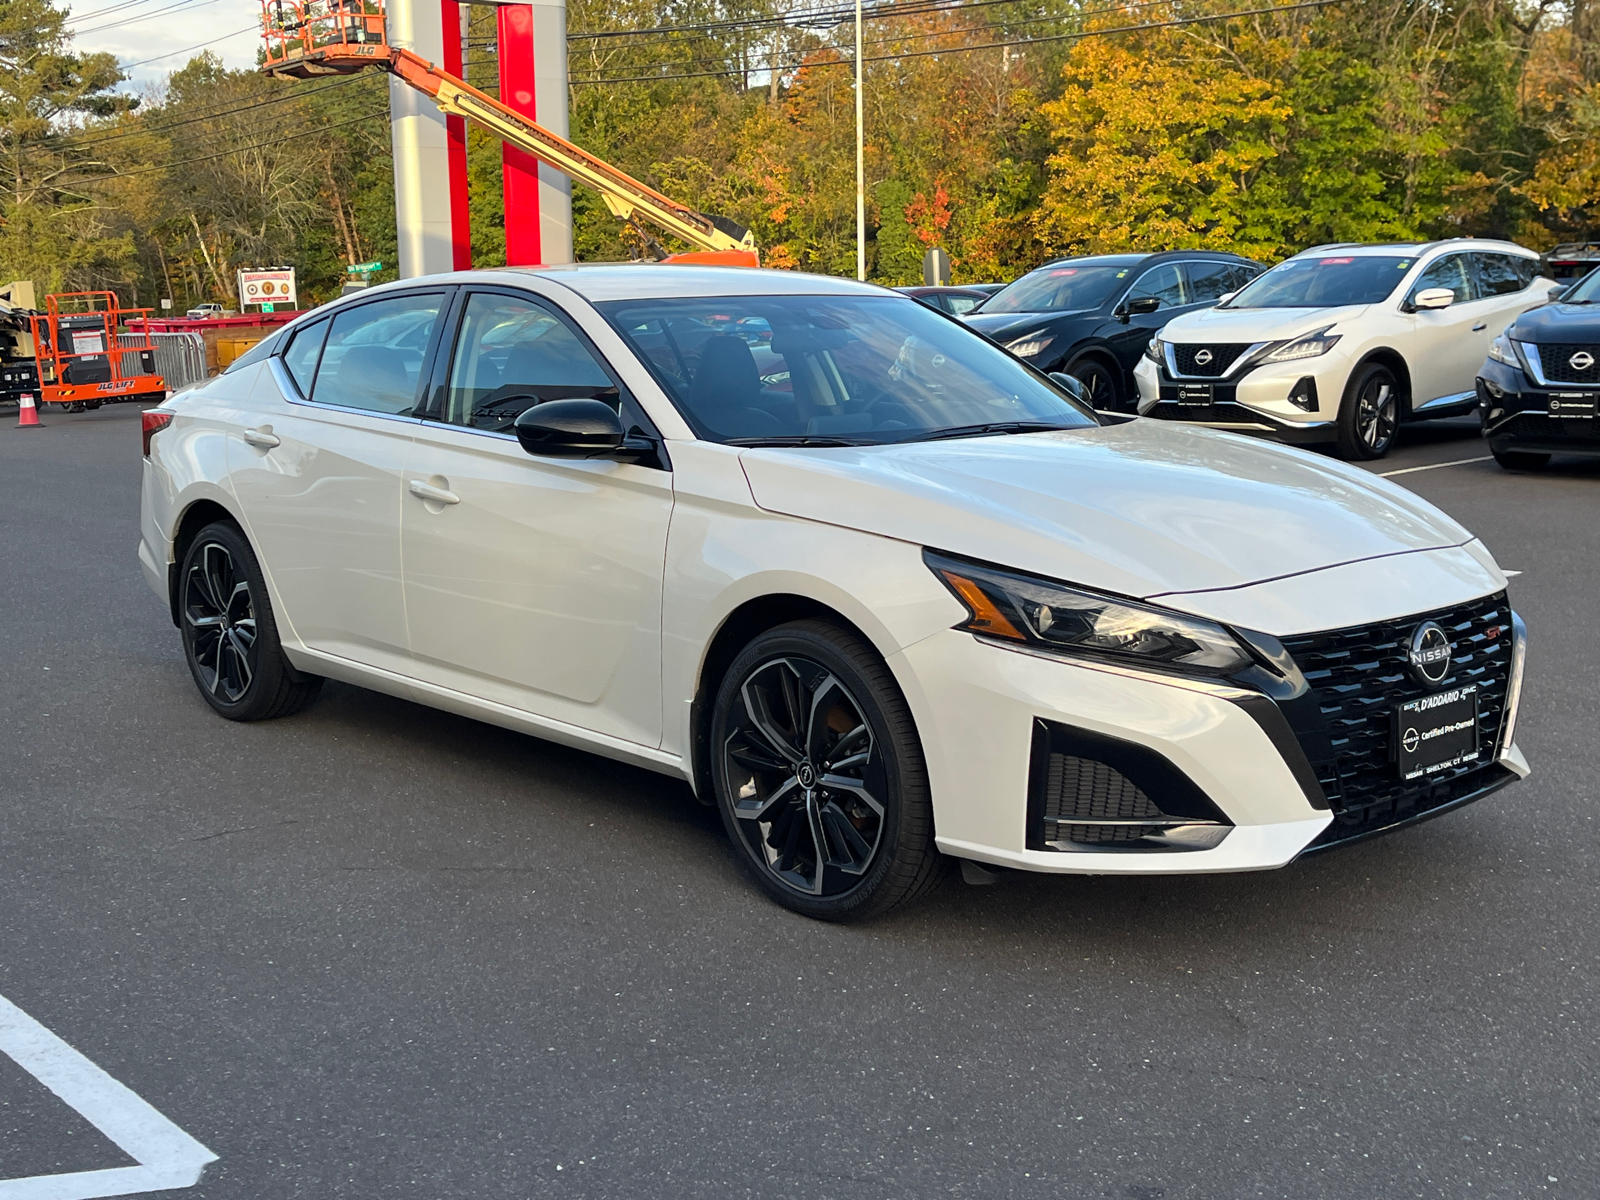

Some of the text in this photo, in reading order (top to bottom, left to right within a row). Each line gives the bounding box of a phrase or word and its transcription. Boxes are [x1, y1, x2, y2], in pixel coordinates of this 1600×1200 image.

[355, 46, 374, 55] JLG
[98, 382, 114, 391] JLG
[116, 380, 135, 388] LIFT
[1410, 645, 1452, 664] NISSAN
[1403, 702, 1420, 711] BUICK
[1421, 690, 1460, 710] D'ADDARIO
[1421, 717, 1475, 740] Certified Pre-Owned
[1402, 735, 1420, 744] NISSAN
[841, 855, 892, 911] BRIDGESTONE
